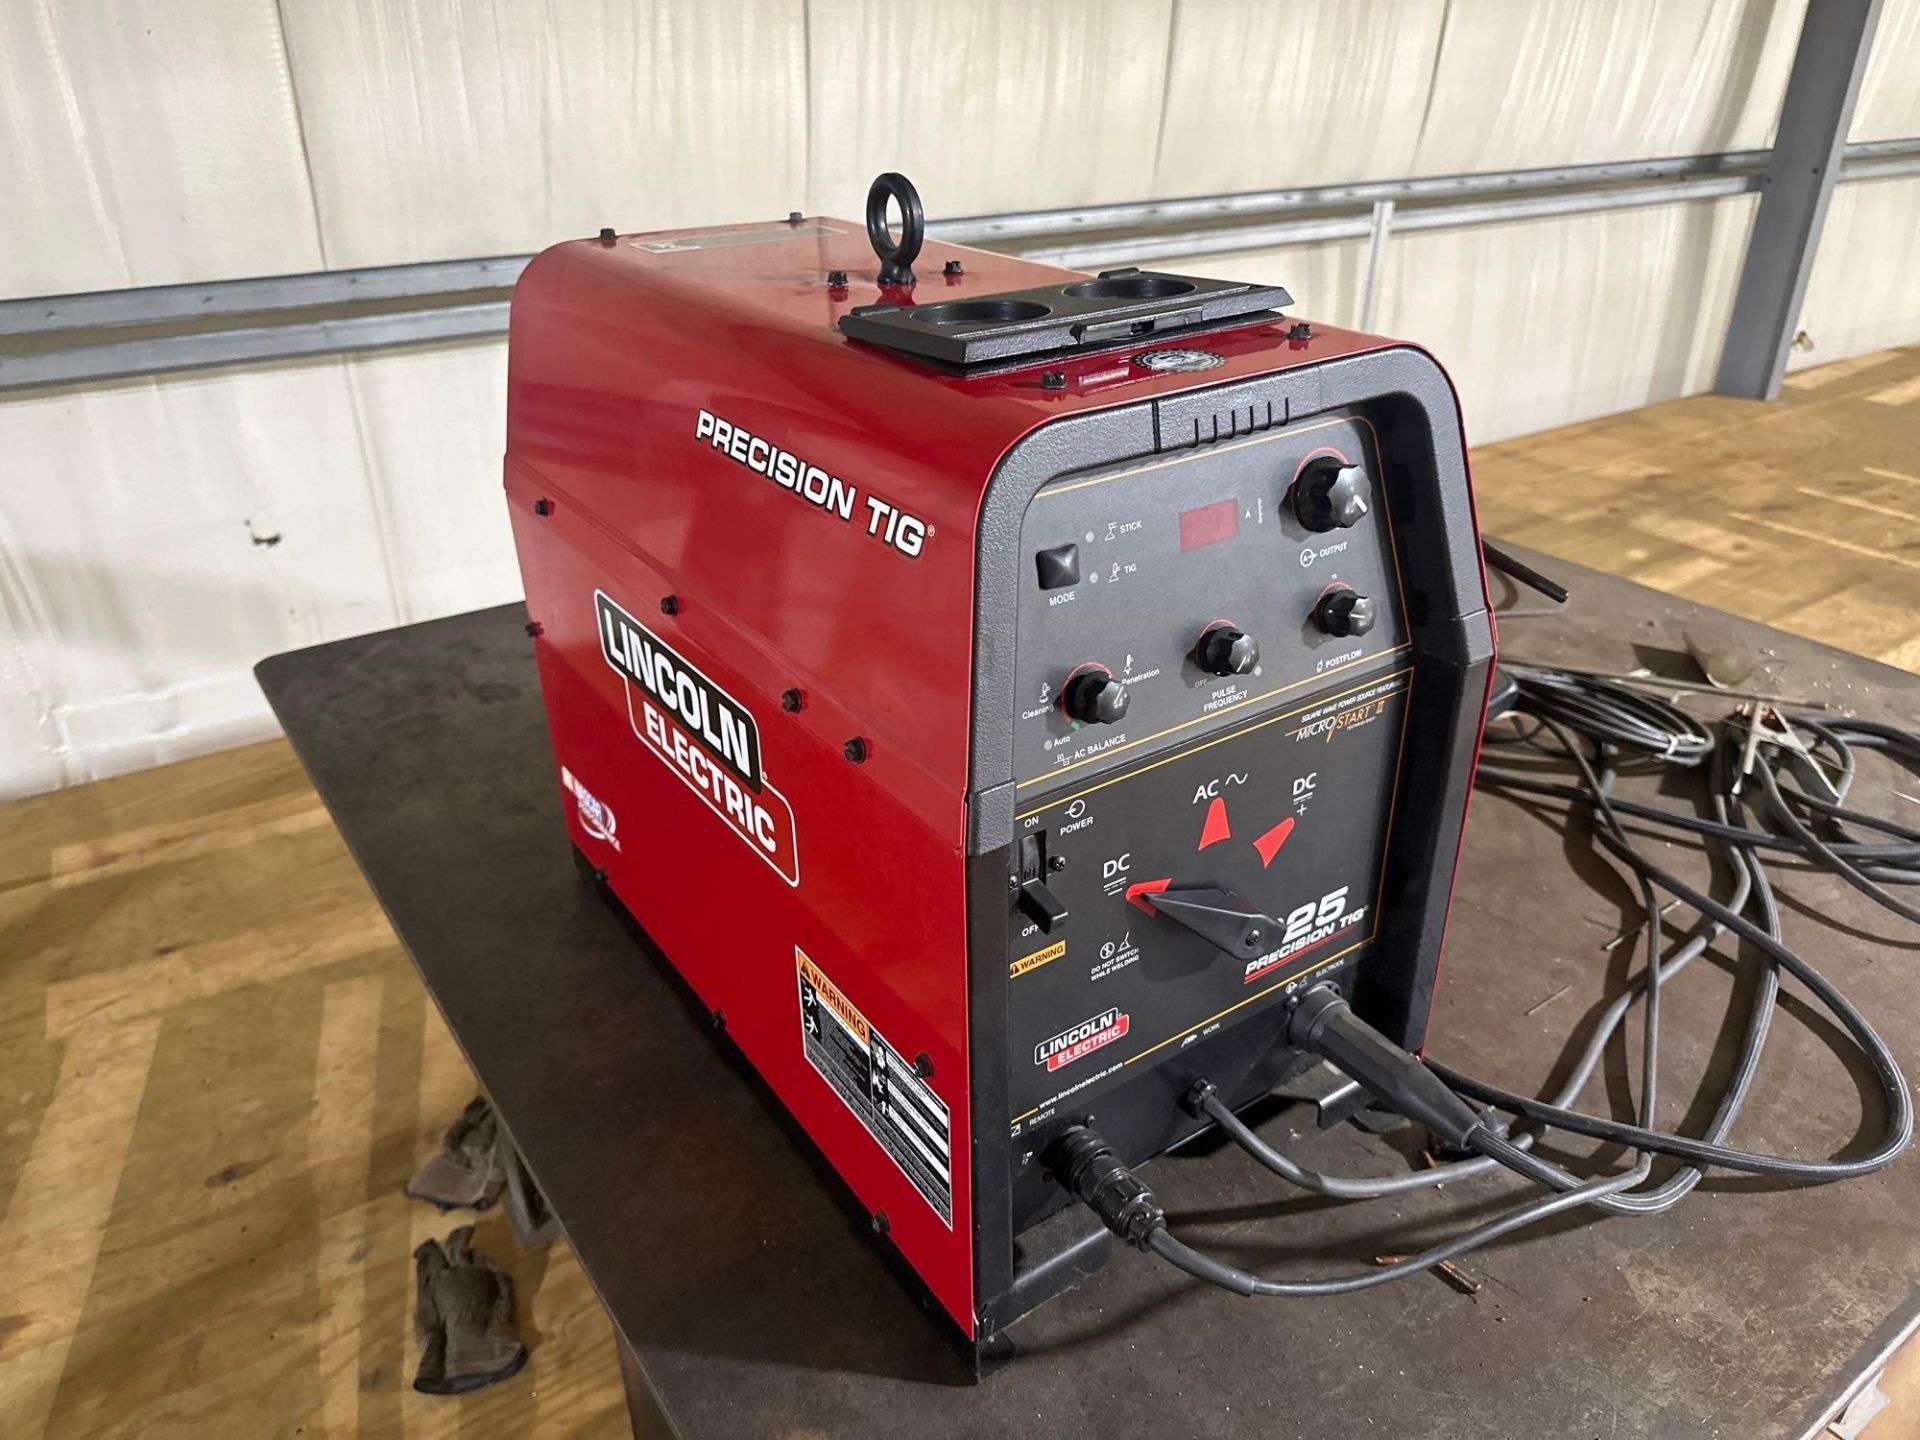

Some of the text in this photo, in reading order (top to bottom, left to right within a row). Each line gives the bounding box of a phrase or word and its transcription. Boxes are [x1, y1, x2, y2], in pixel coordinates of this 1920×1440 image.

[696, 409, 856, 520] PRECISION
[1119, 520, 1143, 534] STICK
[1319, 541, 1348, 557] OUTPUT
[1124, 563, 1137, 574] TIG
[1049, 591, 1076, 607] MODE
[1325, 649, 1362, 668] POSTFLOW
[1121, 668, 1160, 685] Penetration
[604, 607, 752, 778] LINCOLN
[1203, 690, 1247, 712] FREQUENCY
[1212, 684, 1236, 700] PULSE
[1022, 703, 1054, 720] Cleaning
[1296, 716, 1336, 742] MICRO
[1336, 705, 1371, 730] START
[1053, 736, 1071, 747] Auto
[1074, 733, 1127, 760] AC BALANCE
[643, 700, 777, 854] ELECTRIC
[1292, 772, 1317, 796] DC
[1192, 779, 1219, 804] AC
[1024, 816, 1039, 828] ON
[1060, 816, 1094, 836] POWER
[1103, 853, 1131, 878] DC
[1277, 885, 1349, 944] 25
[1019, 945, 1064, 972] WARNING
[1091, 947, 1140, 975] DO NOT SWITCH
[1245, 922, 1335, 976] PRECISION
[1090, 954, 1140, 982] WHILE WELDING
[811, 968, 866, 1039] WARNING
[1040, 1012, 1113, 1060] LINCOLN
[1057, 1025, 1121, 1065] ELECTRIC
[1039, 1062, 1124, 1110] www.lincolnelectric.com
[1029, 1108, 1056, 1126] REMOTE
